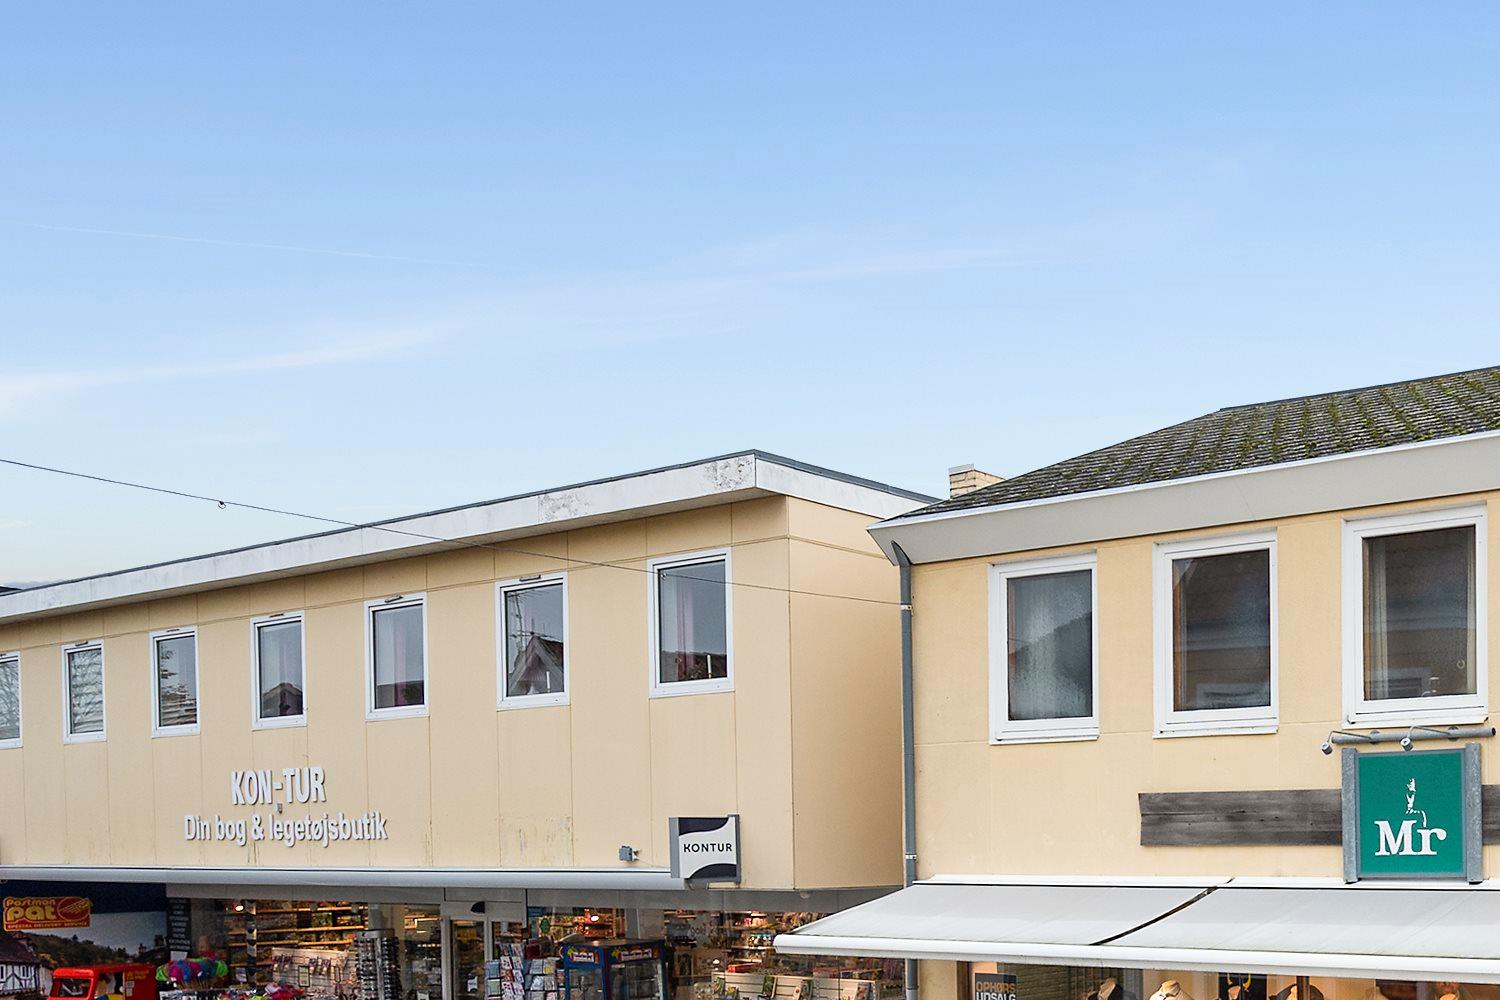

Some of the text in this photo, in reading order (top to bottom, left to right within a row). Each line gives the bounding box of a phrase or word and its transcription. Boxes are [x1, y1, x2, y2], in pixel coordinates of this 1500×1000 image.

[231, 766, 327, 806] KON-TUR
[184, 810, 389, 848] Din bog & legetøjsbutik
[683, 843, 733, 853] KONTUR
[1374, 819, 1448, 857] Mr
